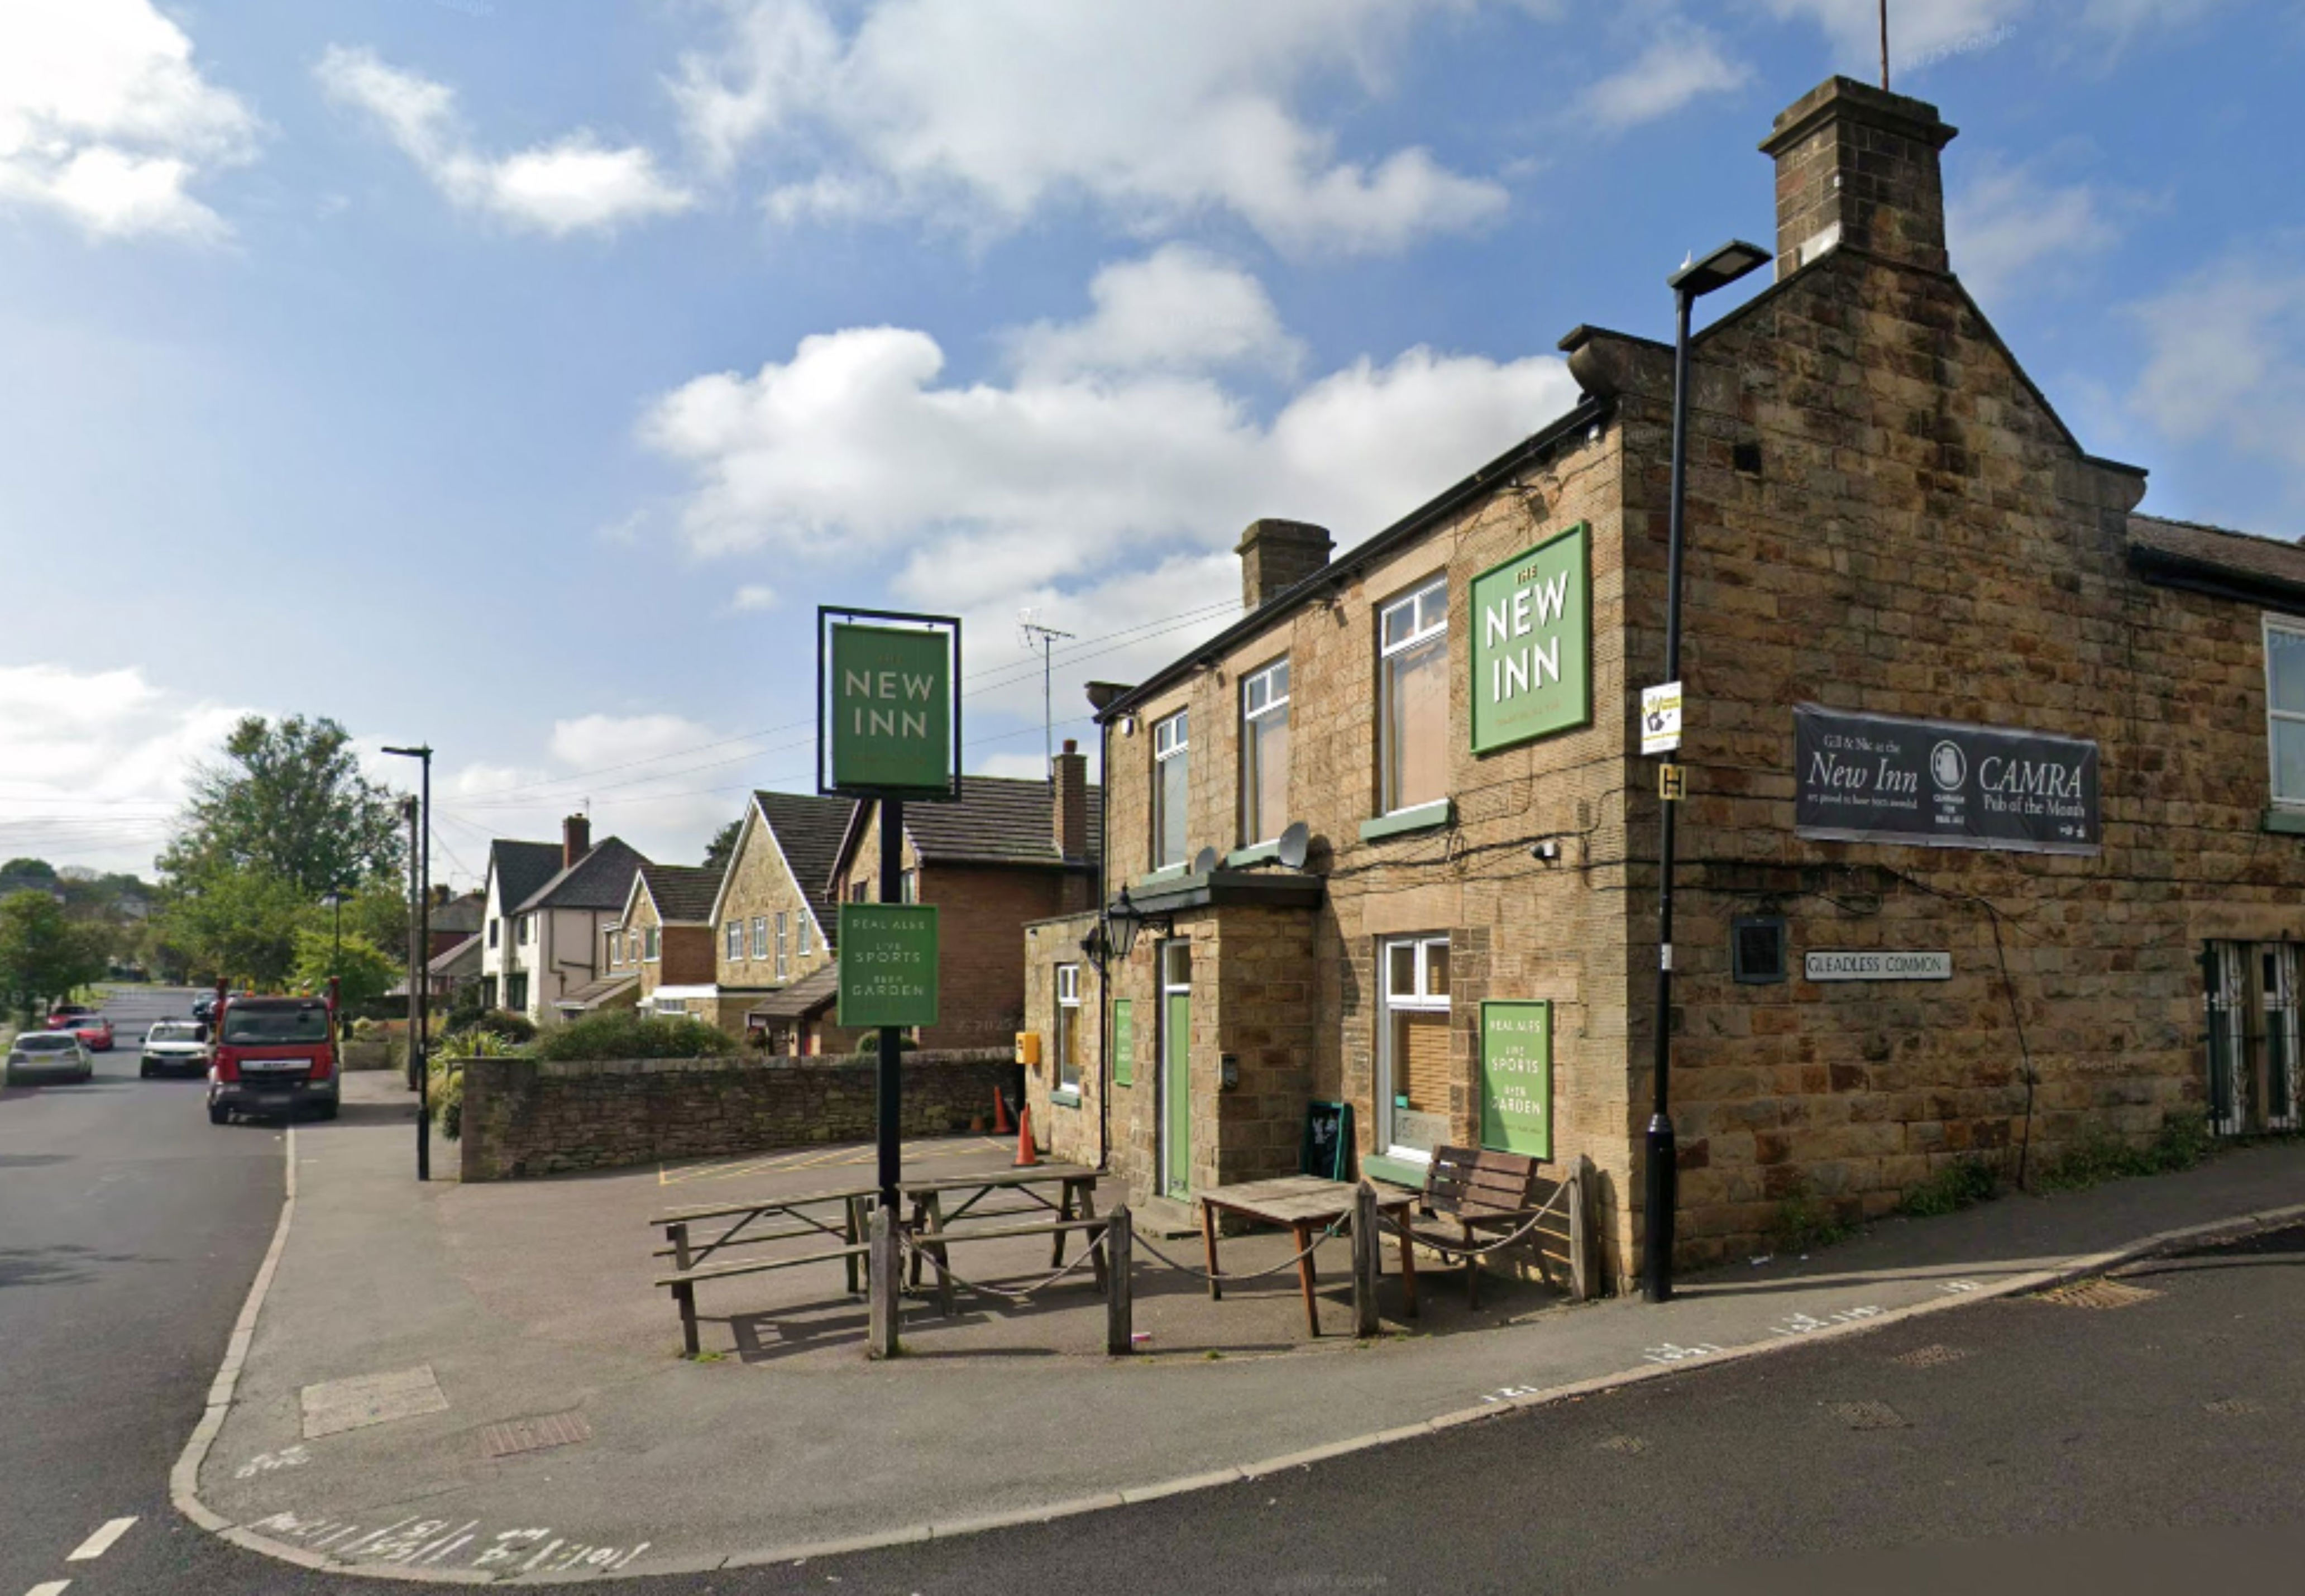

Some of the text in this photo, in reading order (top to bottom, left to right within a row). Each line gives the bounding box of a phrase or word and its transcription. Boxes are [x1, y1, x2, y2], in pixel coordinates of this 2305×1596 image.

[1486, 570, 1568, 649] NEW
[1493, 636, 1561, 703] INN
[845, 669, 934, 701] NEW
[855, 707, 927, 739] INN
[1664, 767, 1682, 797] H
[1806, 751, 1918, 793] New Inn
[1979, 756, 2082, 797] CAMRA
[1984, 794, 2007, 812] Pub
[2008, 795, 2023, 813] of
[2025, 796, 2044, 815] the
[2045, 799, 2085, 818] Month
[853, 919, 886, 930] REAL
[855, 952, 920, 963] SPORTS
[1808, 957, 1941, 972] GLEADLESS COMMON
[853, 985, 923, 996] GARDEN
[1490, 1019, 1514, 1031] REAL
[1491, 1057, 1538, 1074] SPORTS
[1491, 1096, 1541, 1115] GARDEN
